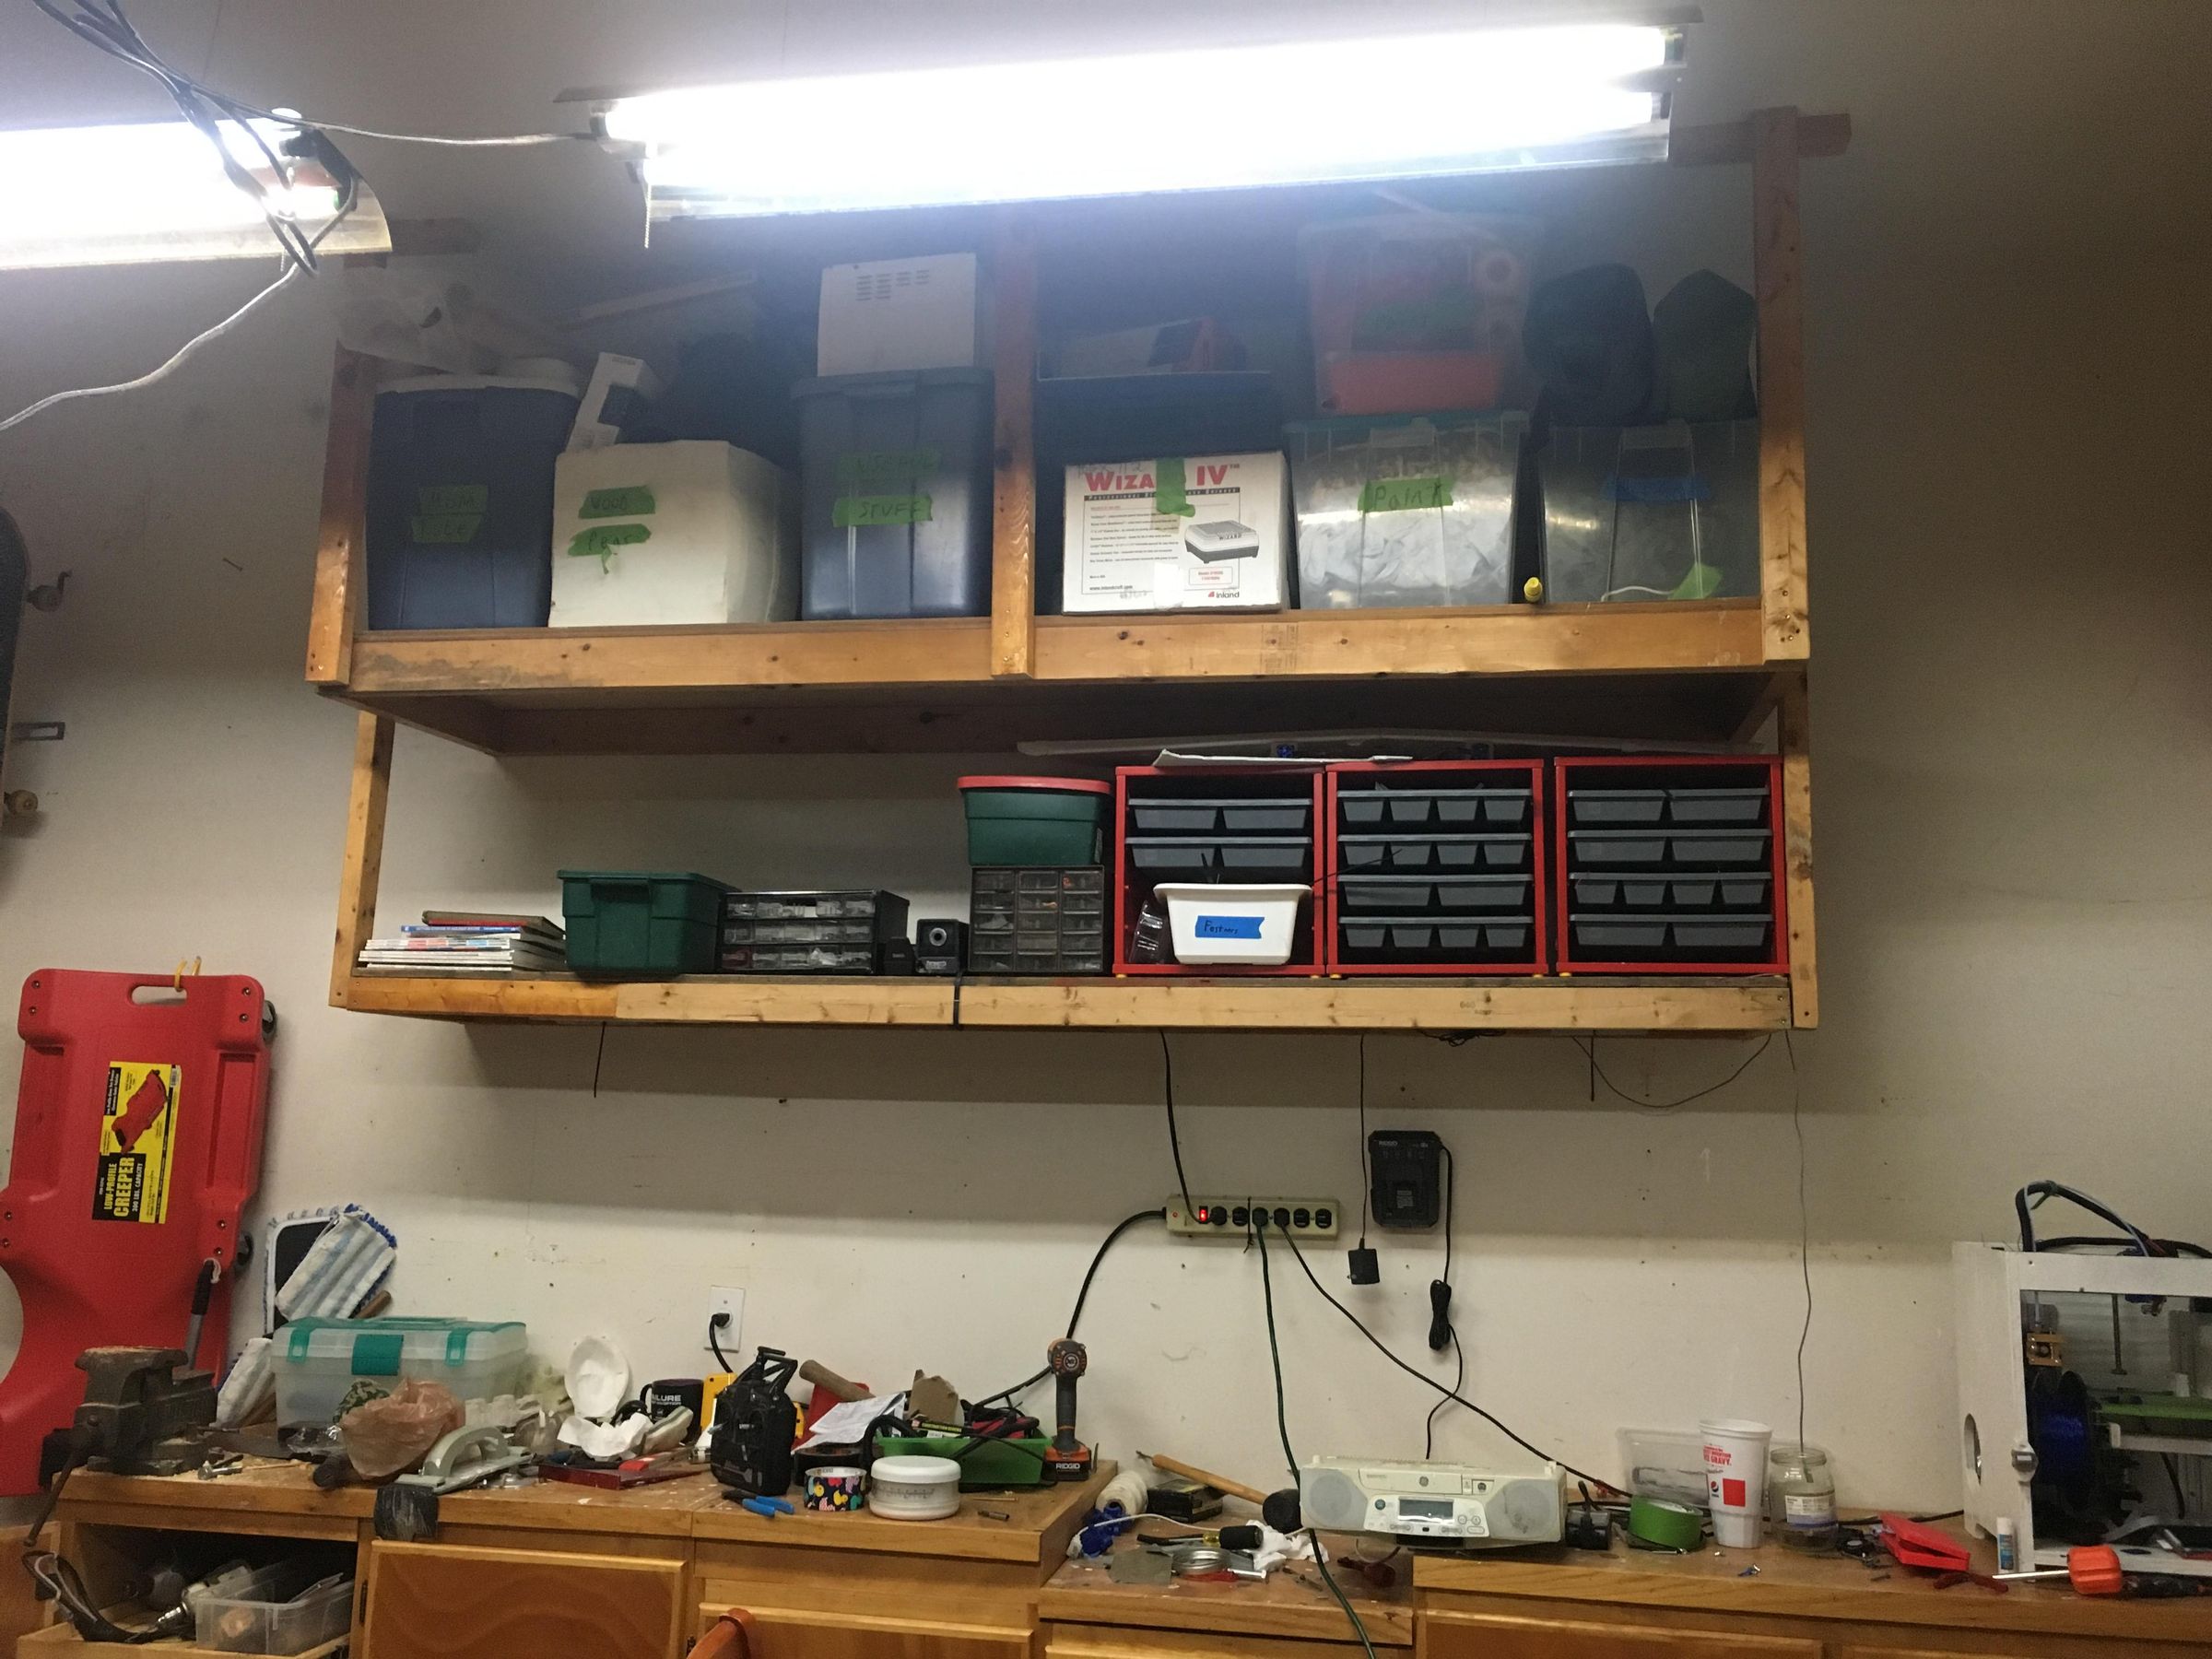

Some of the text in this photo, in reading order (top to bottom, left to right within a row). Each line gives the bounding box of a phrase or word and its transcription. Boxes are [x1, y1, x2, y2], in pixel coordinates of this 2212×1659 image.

[1083, 470, 1155, 492] WIZA
[858, 500, 923, 519] STUFF
[103, 1163, 117, 1210] LOW-PROFILE
[135, 1163, 143, 1187] CAPACITY
[113, 1157, 135, 1217] CREEPER
[1055, 1463, 1081, 1471] RIDGID
